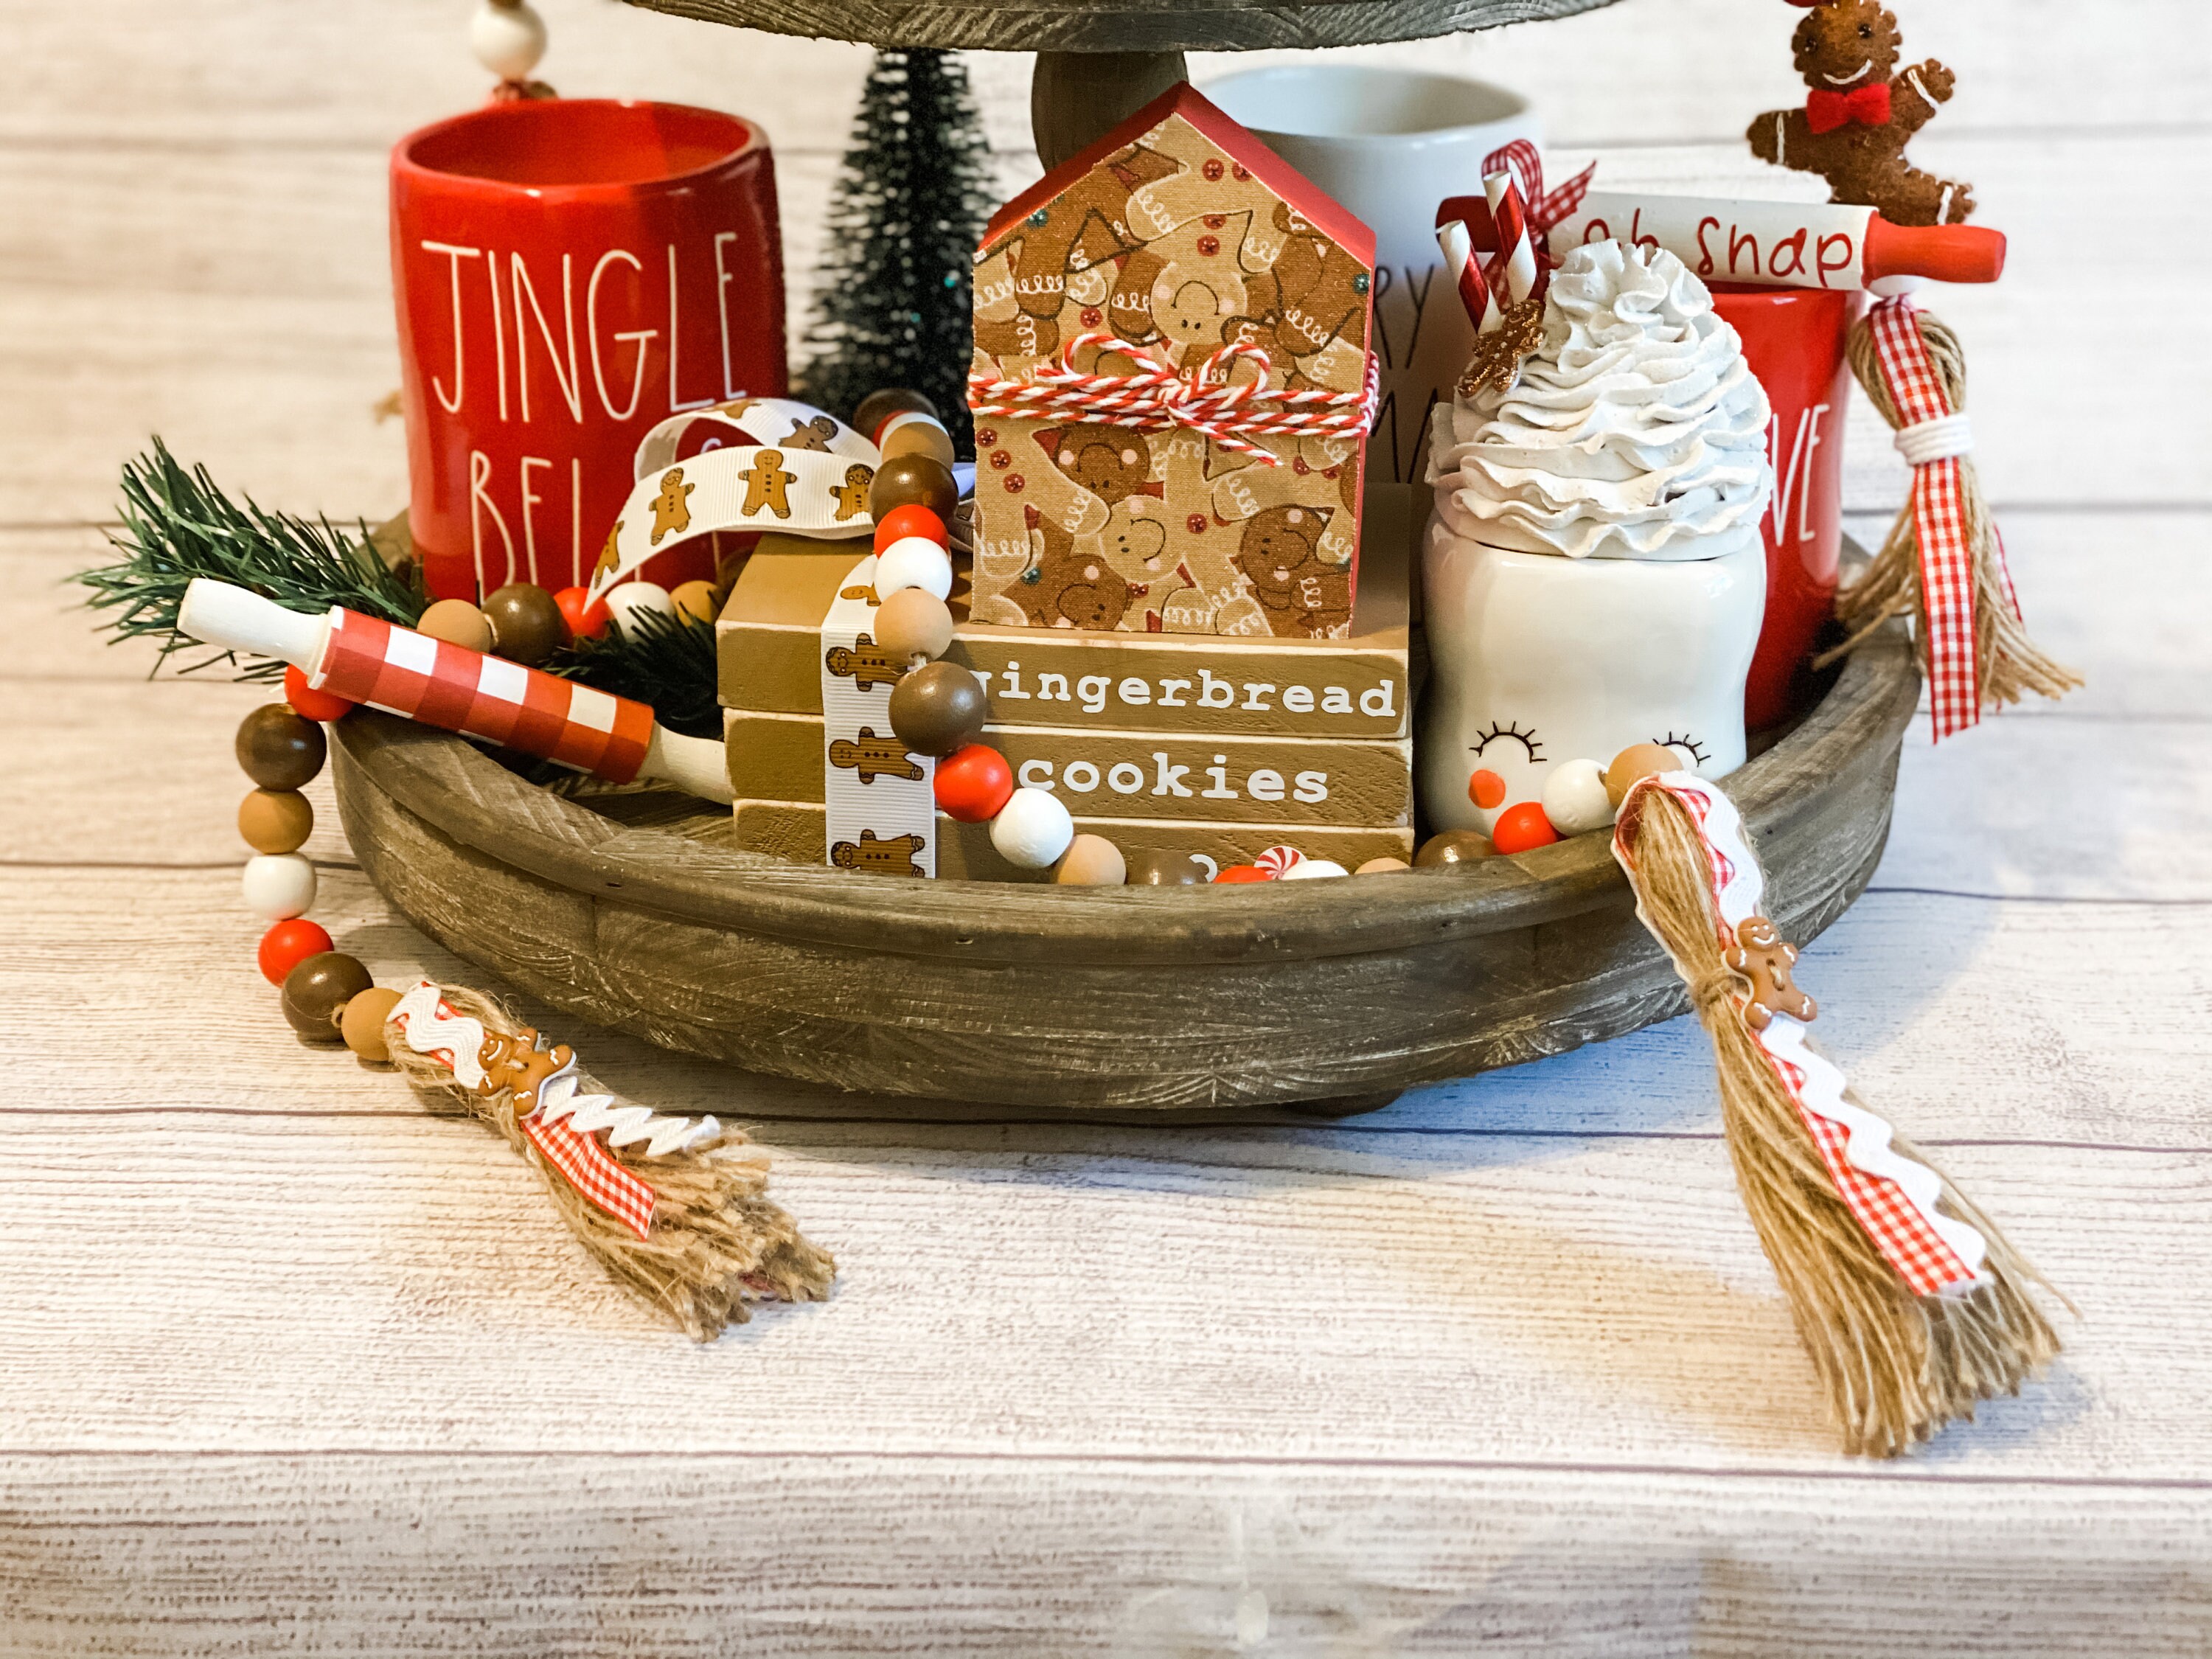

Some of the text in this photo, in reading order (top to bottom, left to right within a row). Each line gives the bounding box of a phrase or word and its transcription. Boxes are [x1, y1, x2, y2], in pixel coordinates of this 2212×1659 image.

[421, 232, 747, 423] JINGLE
[1373, 264, 1434, 369] RY
[1771, 404, 1830, 546] VE
[1018, 751, 1329, 804] cookies
